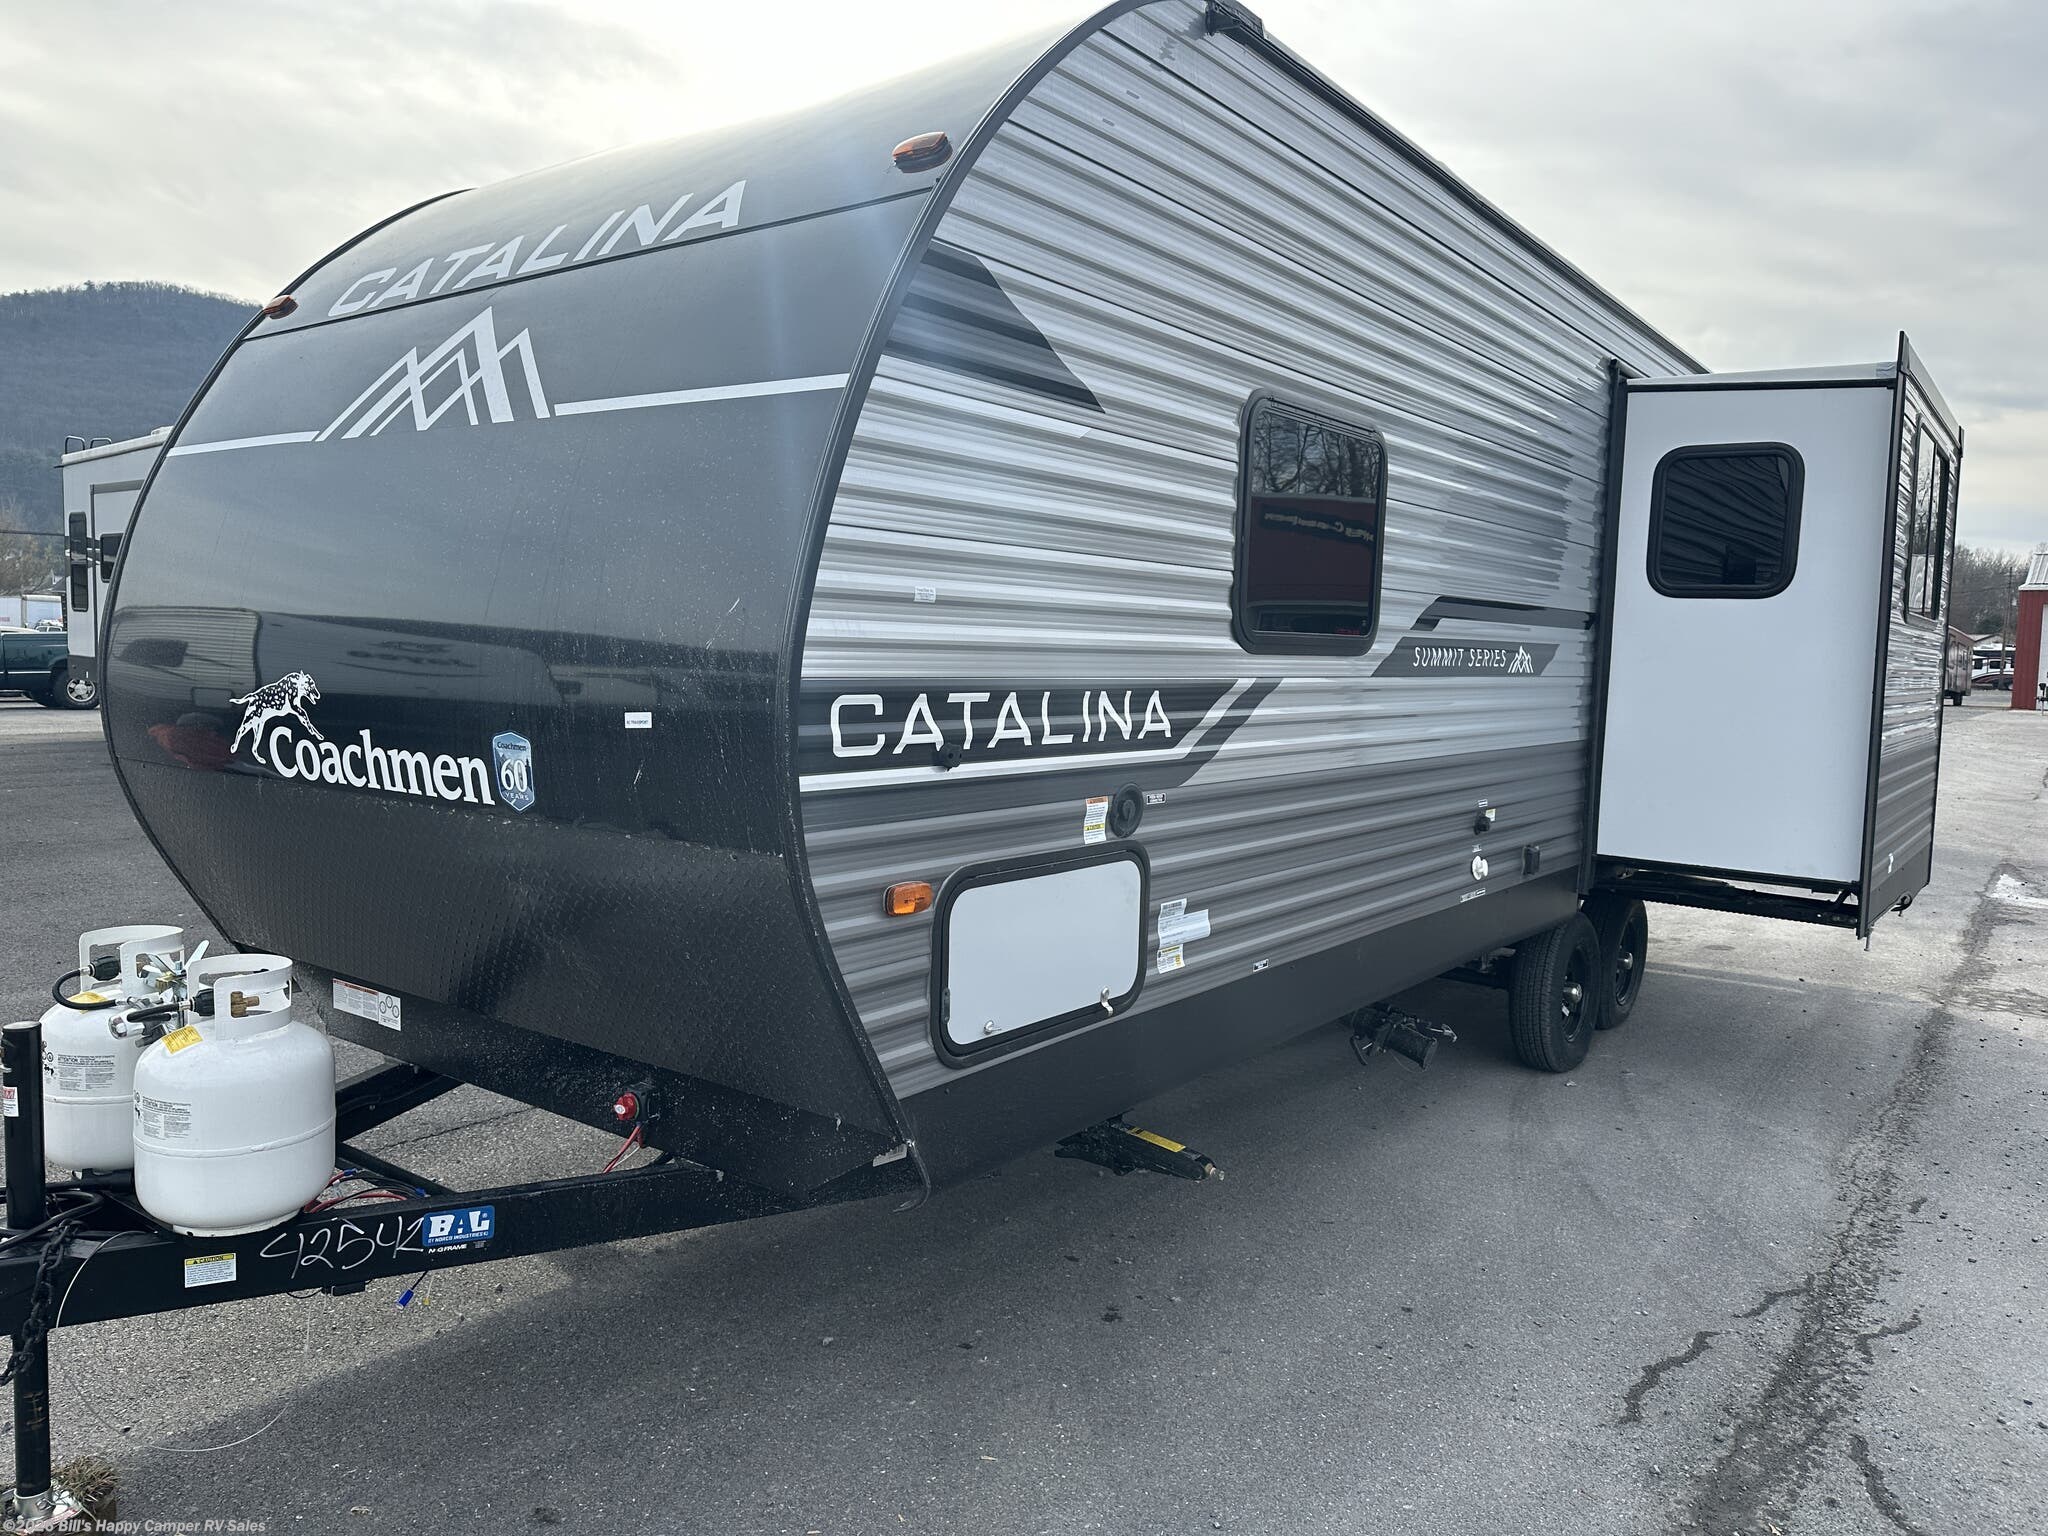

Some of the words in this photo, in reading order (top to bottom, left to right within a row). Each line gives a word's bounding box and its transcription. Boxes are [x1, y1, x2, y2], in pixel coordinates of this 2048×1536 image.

[327, 179, 747, 317] CATALINA
[1413, 646, 1465, 667] SUMMIT
[1468, 648, 1507, 667] SERIES
[830, 690, 1172, 758] CATALINA
[497, 741, 527, 752] Coachmen
[269, 728, 496, 806] Coachmen
[501, 758, 528, 793] 60
[505, 792, 530, 801] YEARS
